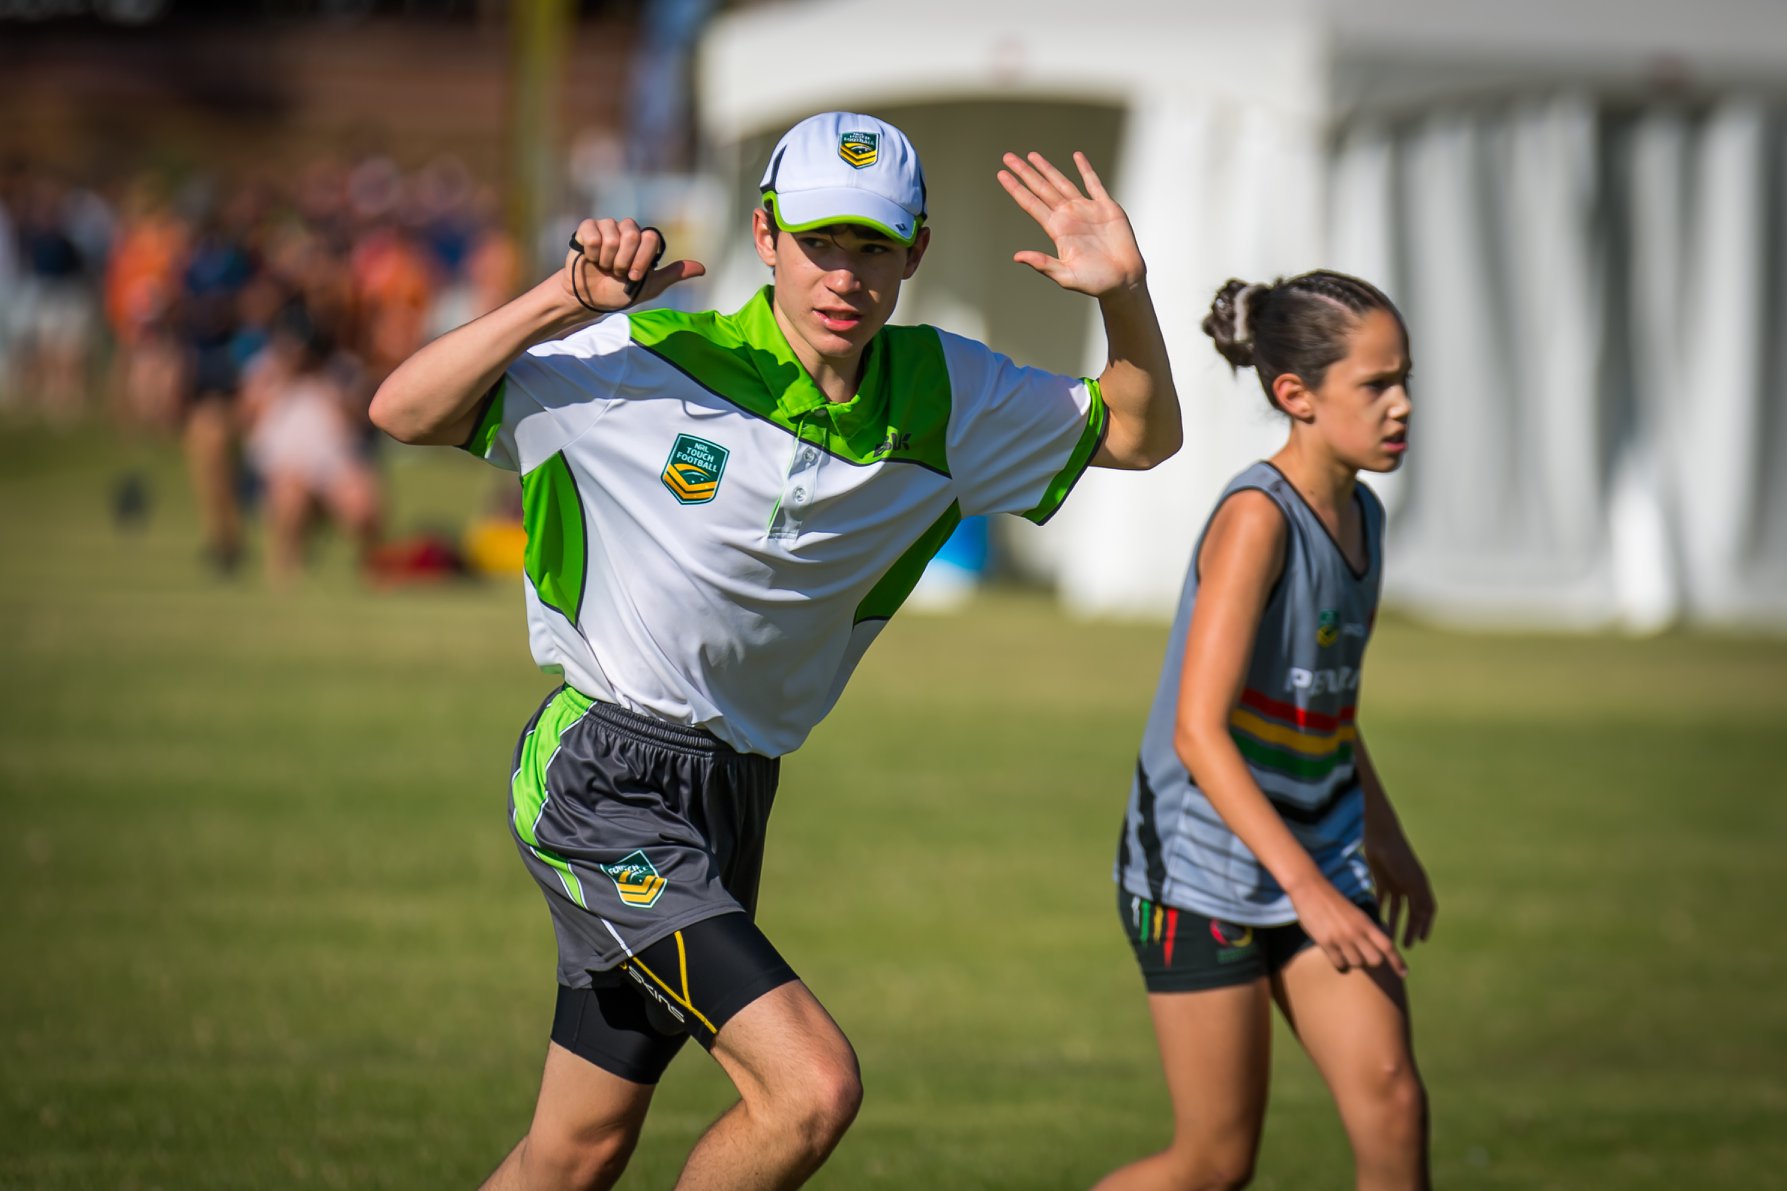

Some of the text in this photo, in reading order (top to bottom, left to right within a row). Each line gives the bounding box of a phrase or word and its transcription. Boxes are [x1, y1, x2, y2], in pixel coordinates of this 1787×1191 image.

[686, 446, 715, 463] TOUCH
[694, 442, 710, 453] NRL
[676, 451, 718, 473] FOOTBALL
